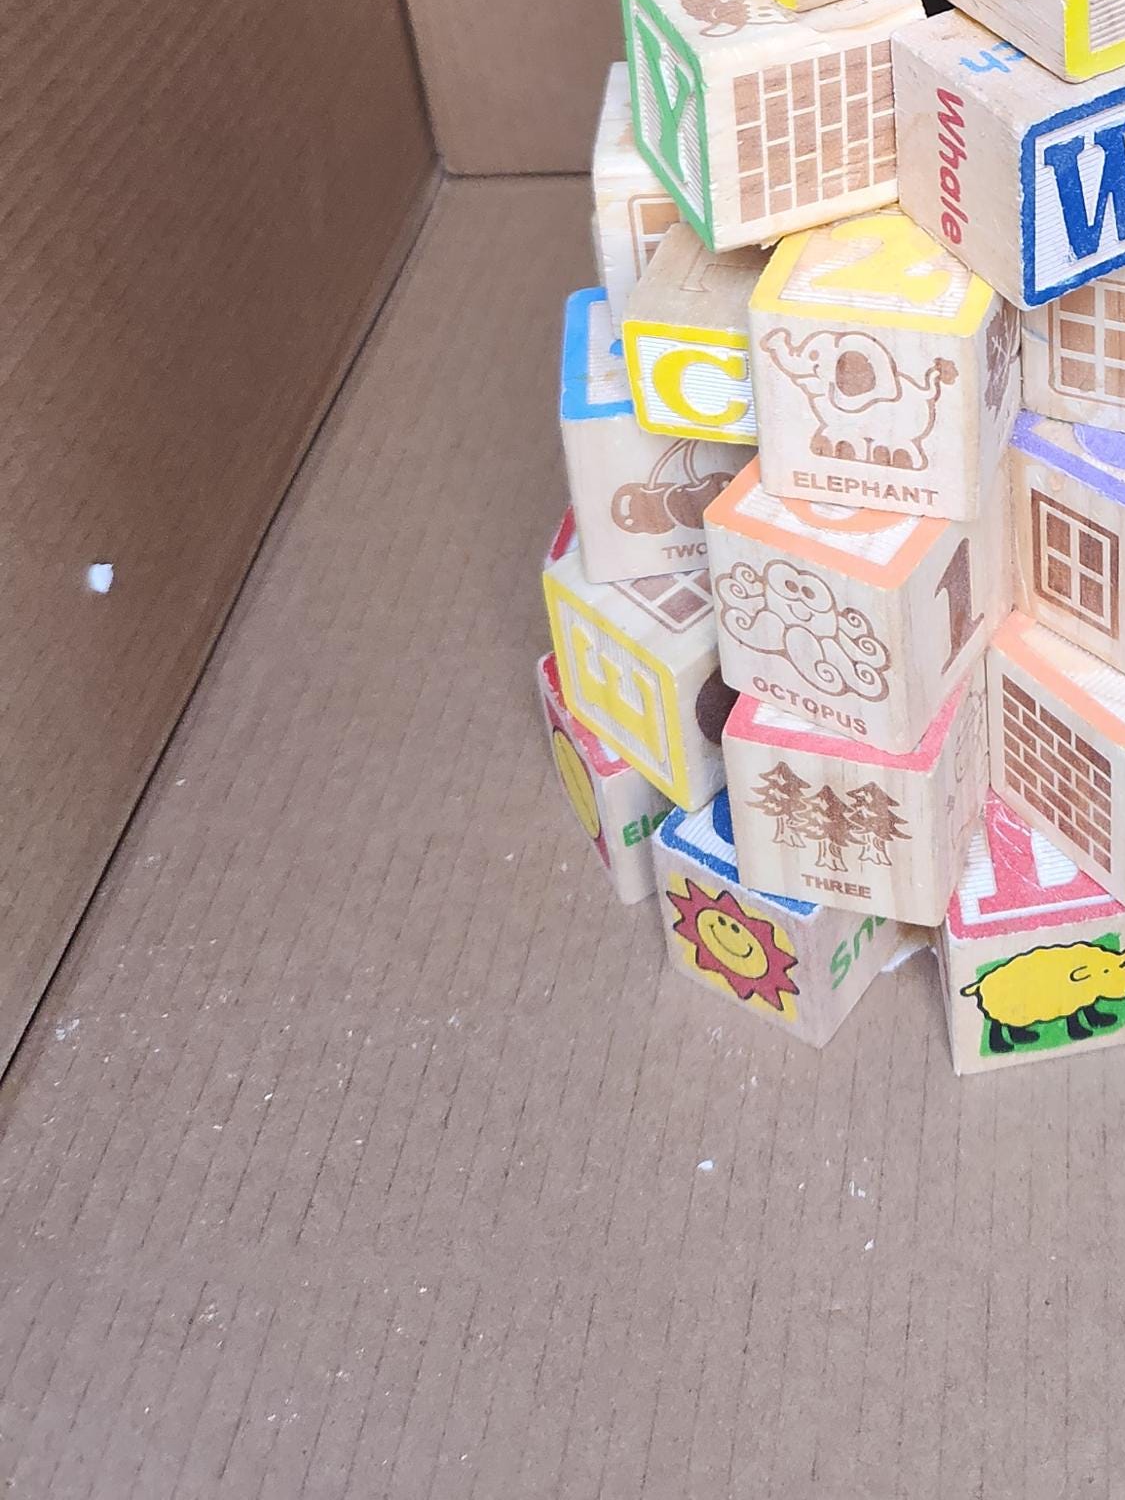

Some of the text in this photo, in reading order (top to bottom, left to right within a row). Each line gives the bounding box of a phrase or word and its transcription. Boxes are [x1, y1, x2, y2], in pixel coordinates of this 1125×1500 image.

[635, 13, 695, 184] Y
[936, 87, 970, 245] Whale
[652, 348, 749, 428] C
[792, 469, 939, 507] ELEPHANT
[933, 536, 985, 676] 1
[570, 623, 666, 763] E
[752, 675, 869, 736] OCTOPUS
[800, 872, 872, 899] THREE
